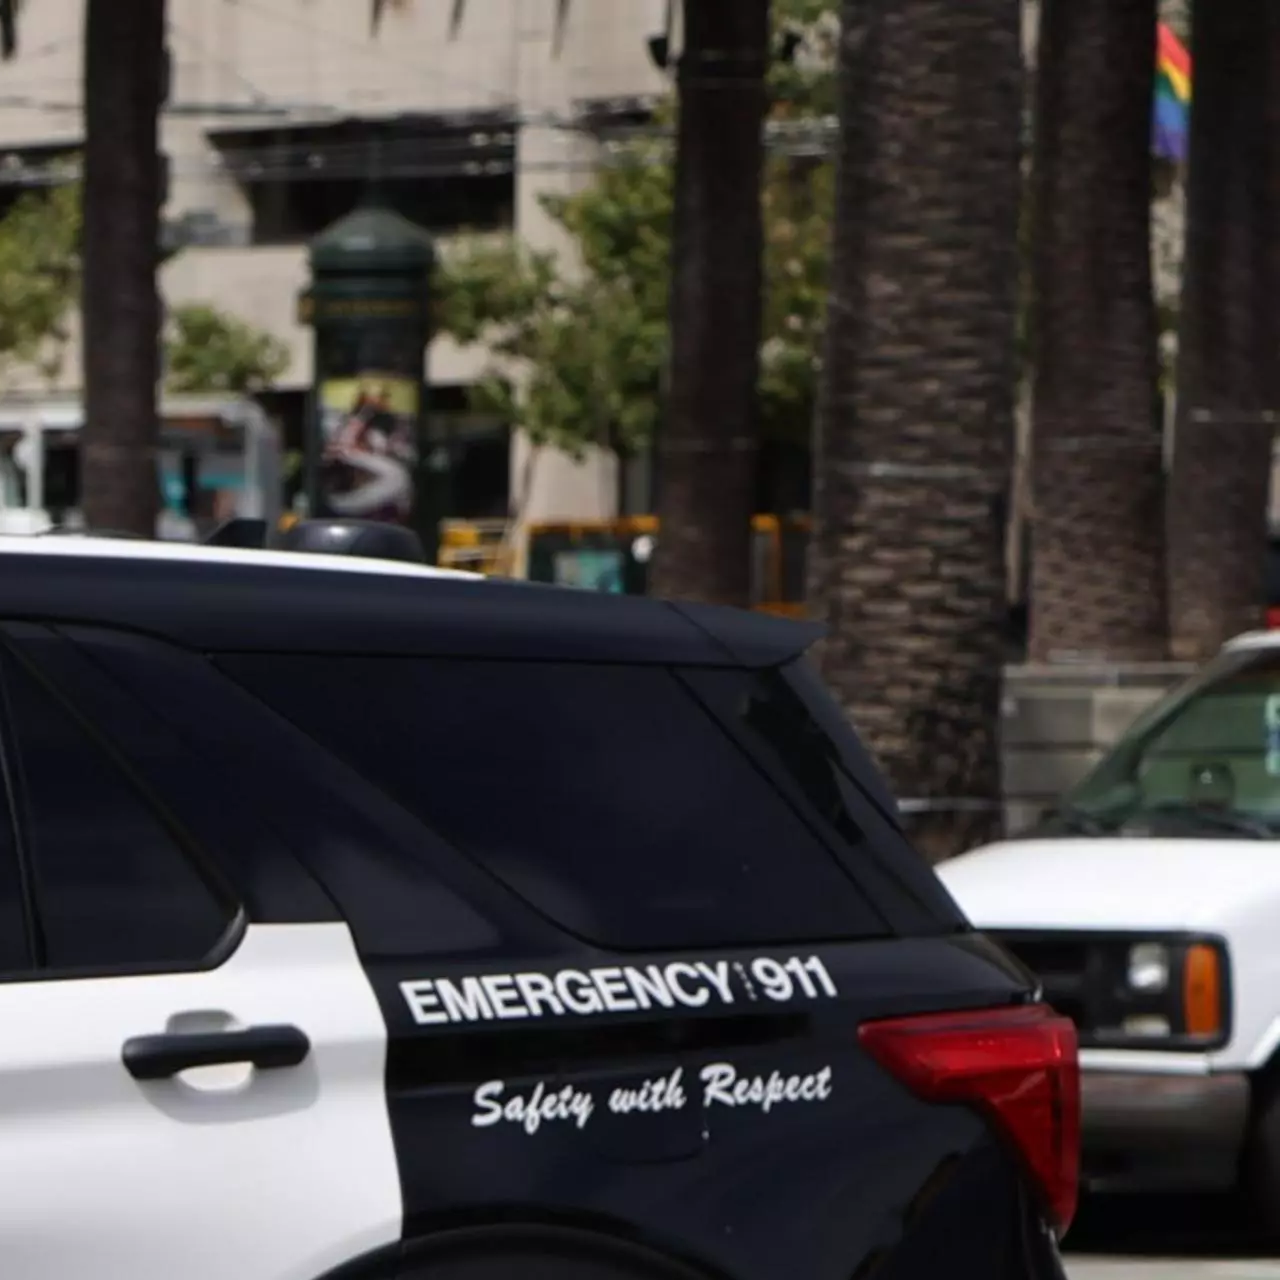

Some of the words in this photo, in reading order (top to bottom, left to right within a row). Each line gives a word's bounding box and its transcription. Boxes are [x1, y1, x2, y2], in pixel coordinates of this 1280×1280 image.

[399, 961, 734, 1025] EMERGENCY
[751, 956, 838, 1001] 911
[471, 1079, 594, 1135] Safety
[608, 1066, 687, 1114] with
[699, 1062, 833, 1114] Respect
